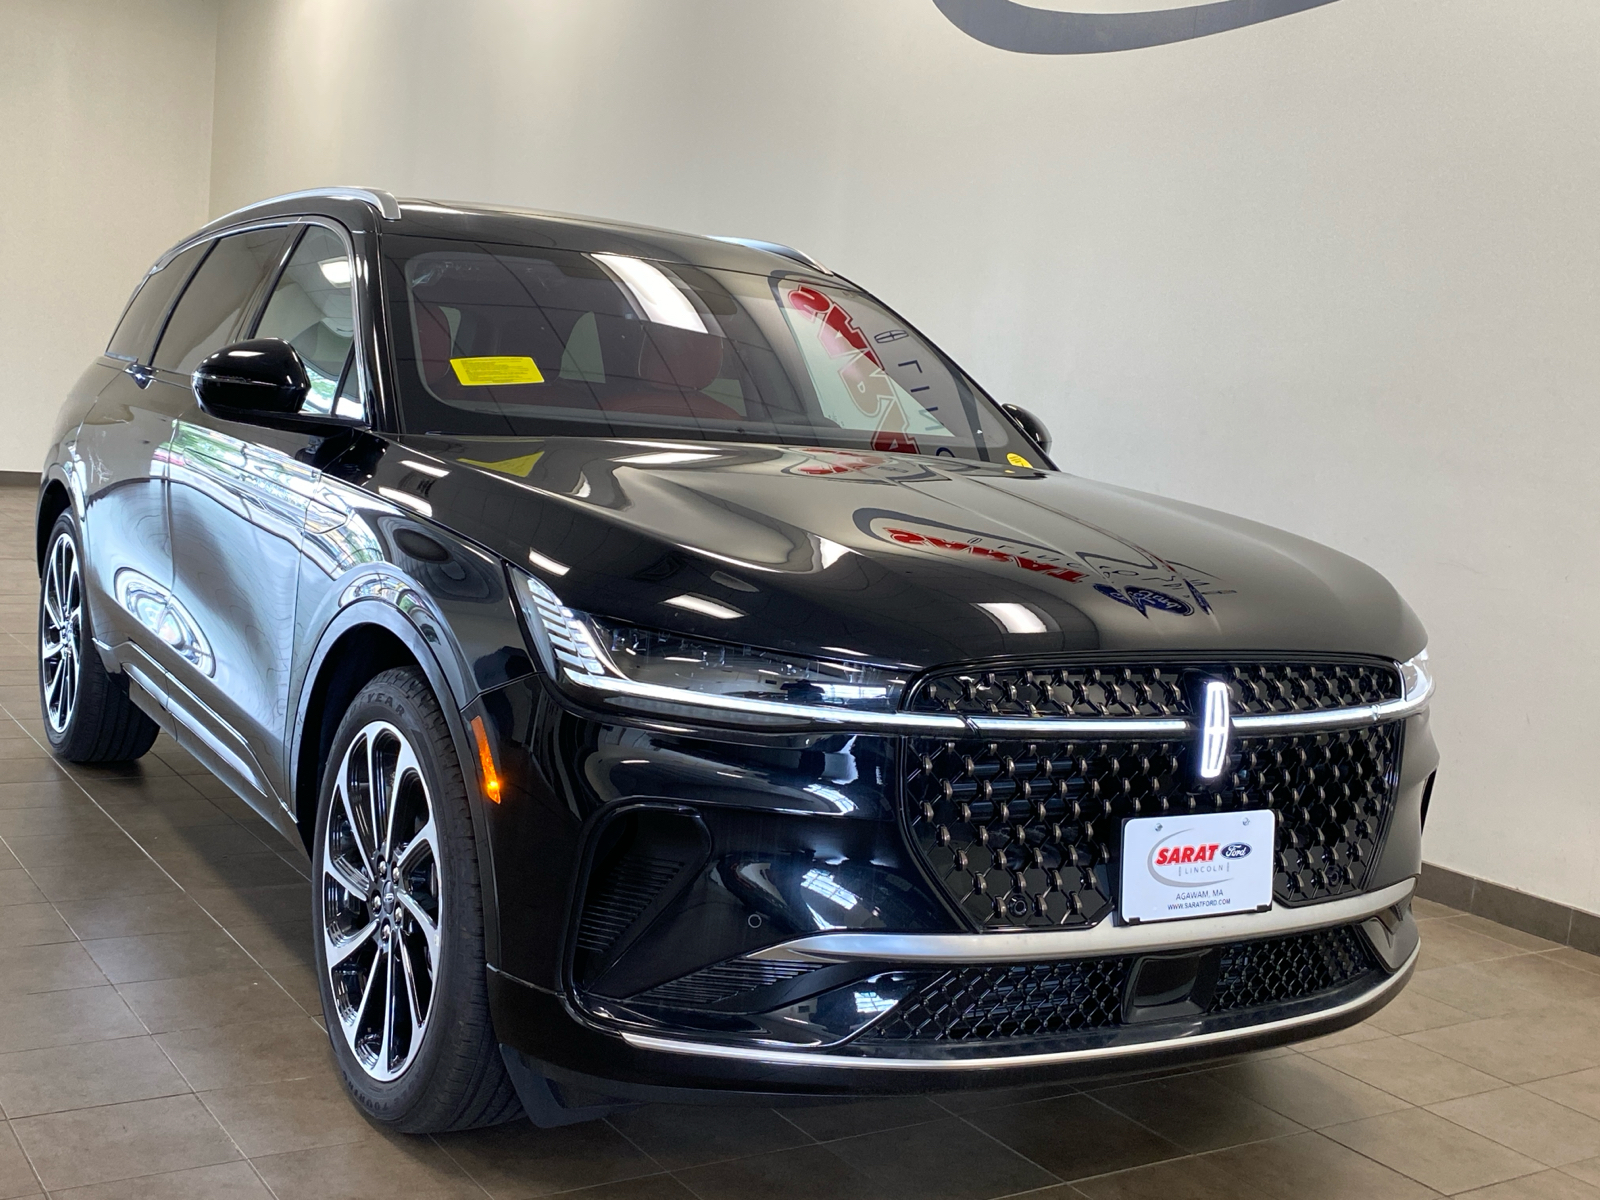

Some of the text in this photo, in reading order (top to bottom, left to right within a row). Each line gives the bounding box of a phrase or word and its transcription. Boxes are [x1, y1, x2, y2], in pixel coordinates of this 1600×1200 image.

[1155, 843, 1250, 866] SARAT Ford
[1184, 865, 1224, 875] LINCOLN
[1175, 889, 1224, 901] AGAWAM, MA
[1167, 898, 1231, 911] WWW.SARATFORD.COM
